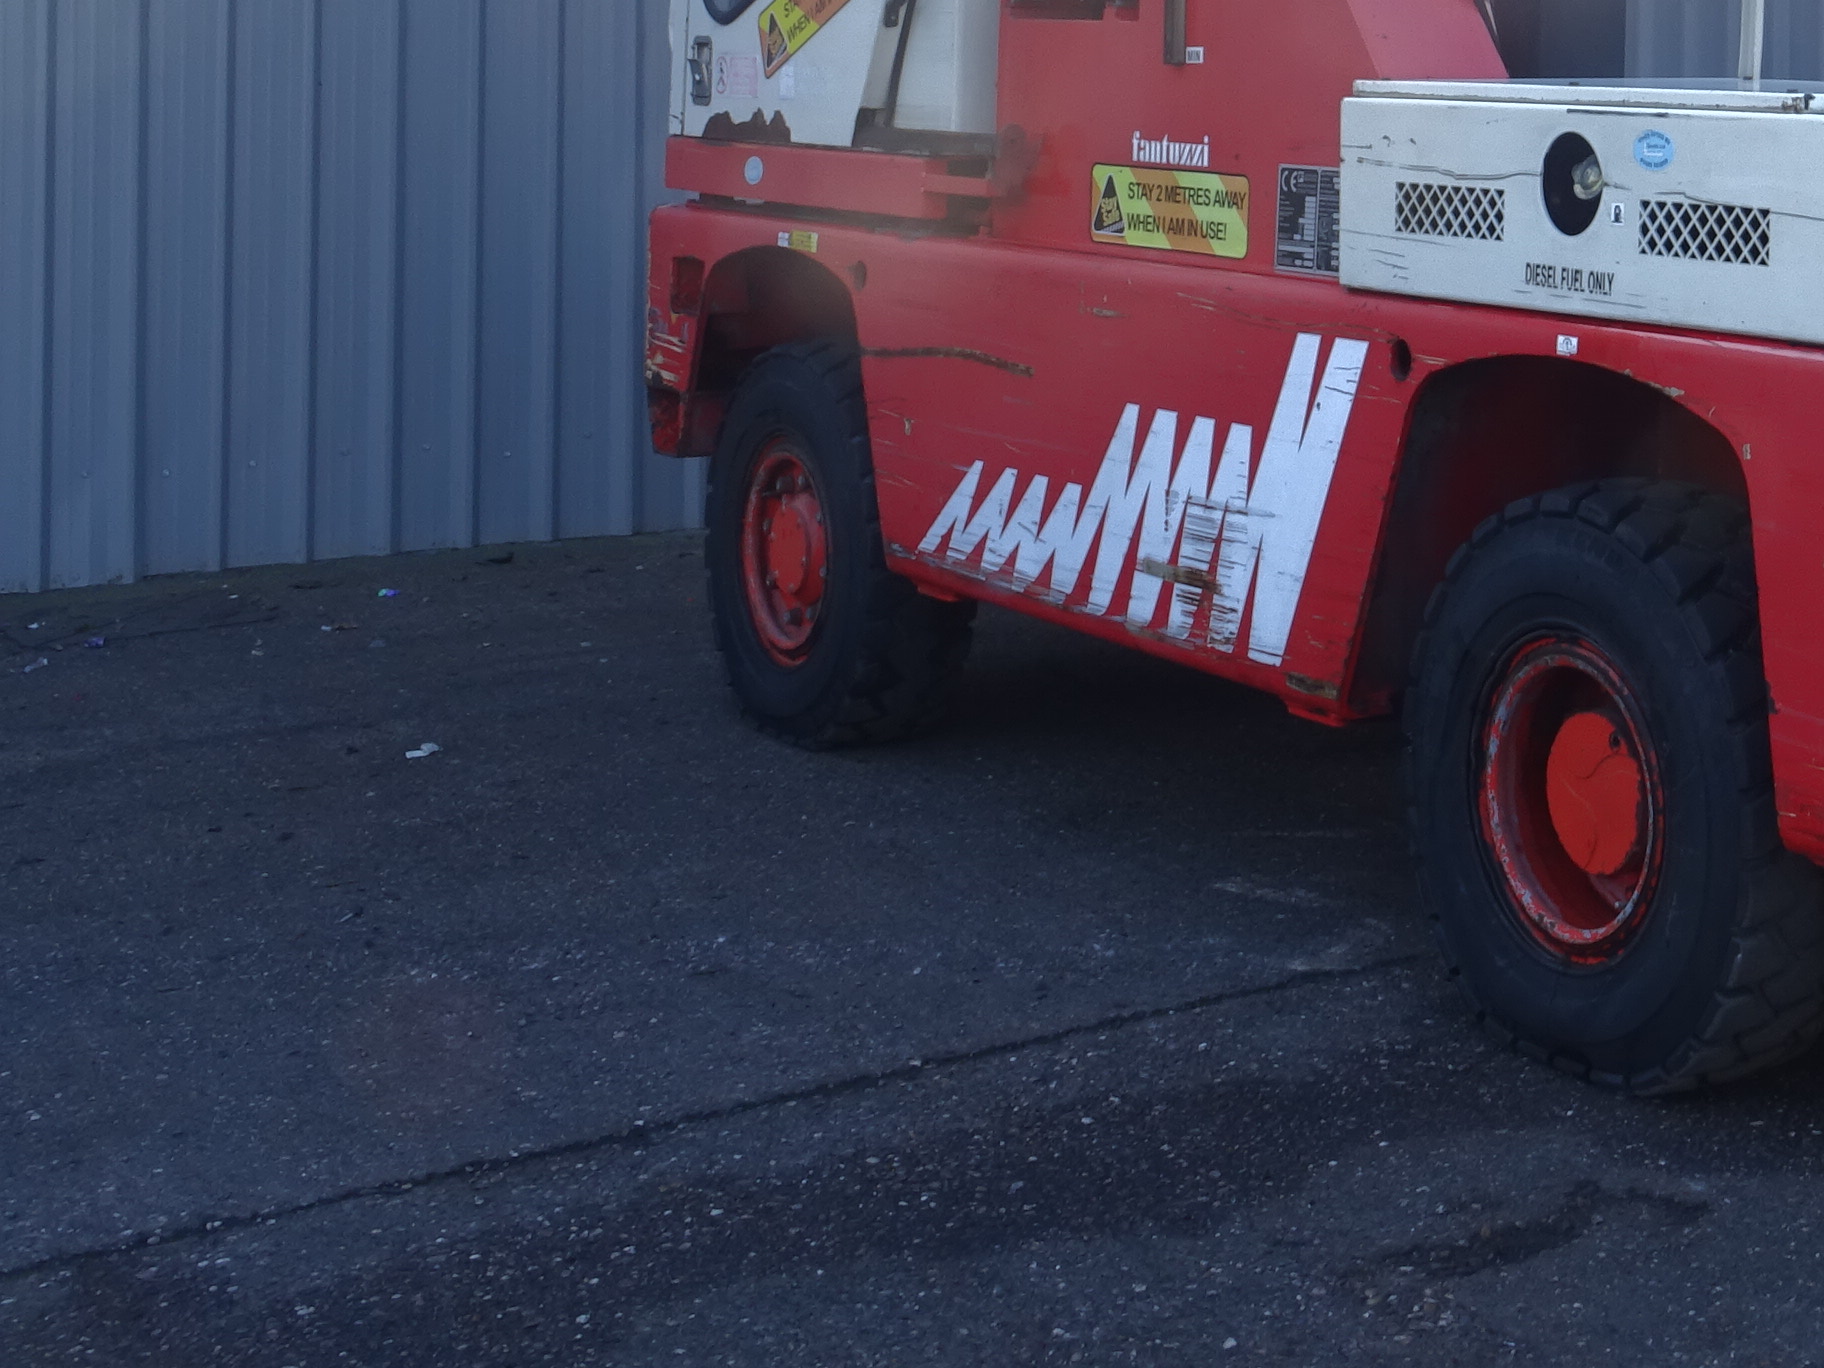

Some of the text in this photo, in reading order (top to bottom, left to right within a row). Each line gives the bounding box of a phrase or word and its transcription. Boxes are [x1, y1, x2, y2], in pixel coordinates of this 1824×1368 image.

[1188, 50, 1201, 61] MIN
[1132, 130, 1209, 167] fantuzzi
[1127, 182, 1247, 210] STAY 2 METRES AWAY
[1127, 213, 1160, 233] WHEN
[1167, 218, 1185, 234] AM
[1187, 219, 1198, 237] IN
[1200, 220, 1227, 241] USE!
[1525, 262, 1615, 296] DIESEL FUEL ONLY
